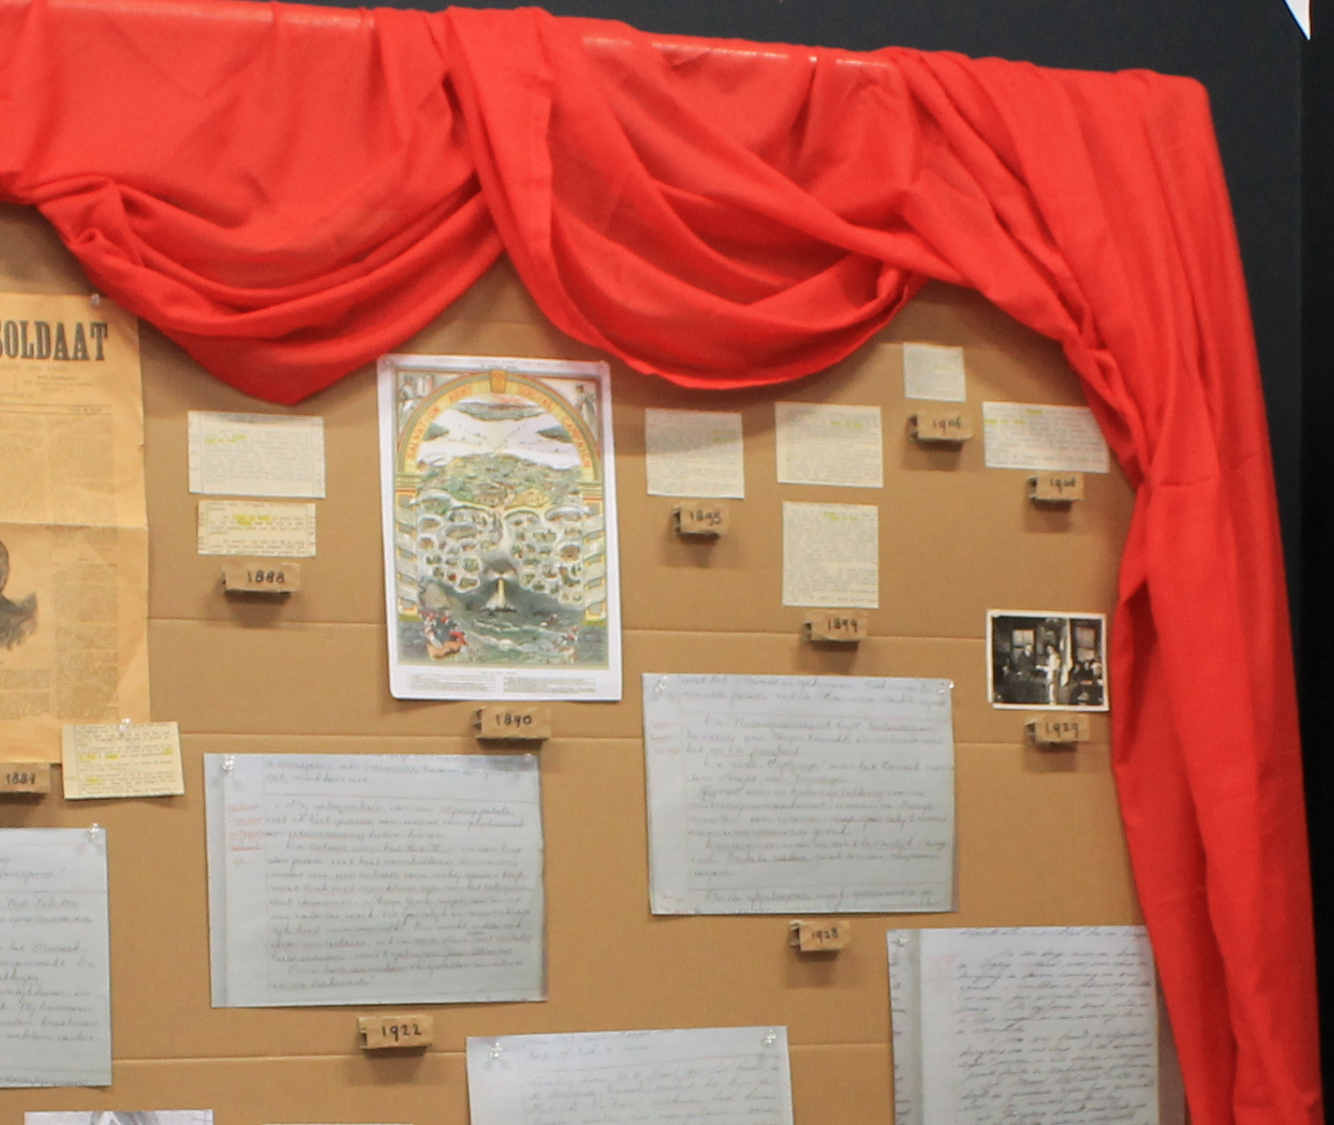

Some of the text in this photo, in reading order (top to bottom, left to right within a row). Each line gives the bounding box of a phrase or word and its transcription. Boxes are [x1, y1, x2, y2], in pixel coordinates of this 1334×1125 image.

[1045, 721, 1080, 738] 1929
[811, 927, 839, 942] 1928
[381, 1024, 422, 1041] 1922
